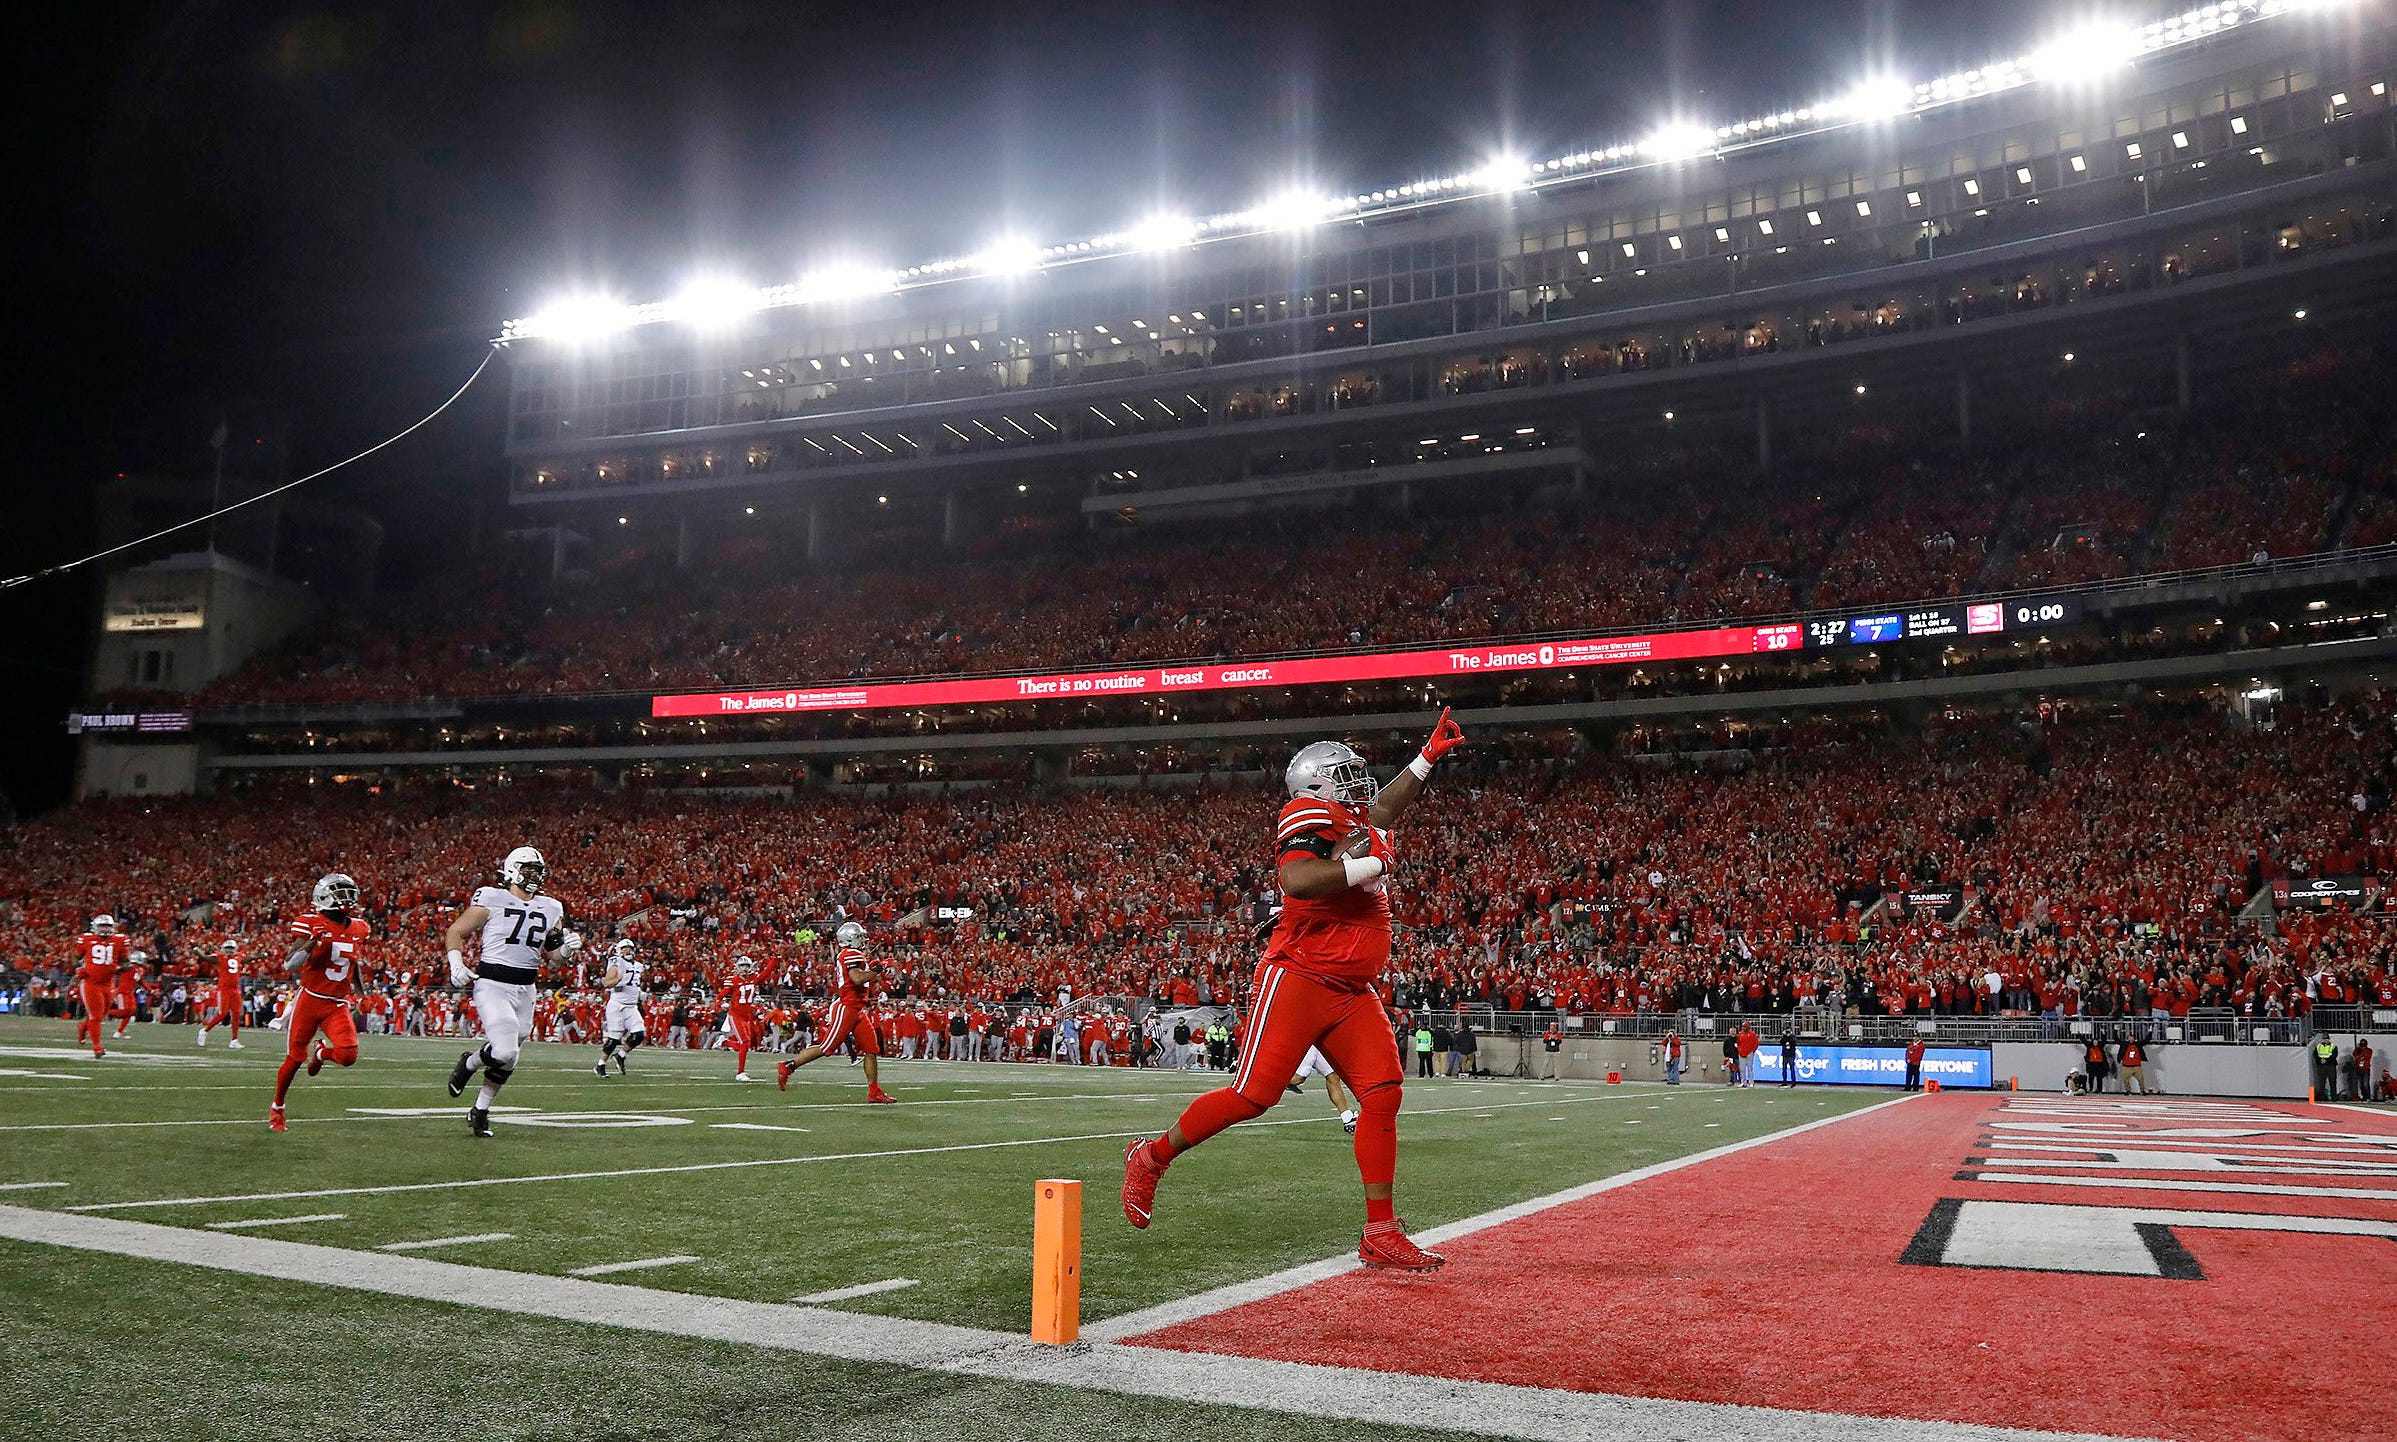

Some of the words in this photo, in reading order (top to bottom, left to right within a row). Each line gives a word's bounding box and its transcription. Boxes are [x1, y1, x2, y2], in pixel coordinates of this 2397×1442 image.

[1879, 615, 1898, 625] STATE
[2017, 604, 2064, 623] 0:00
[1775, 625, 1798, 635] STATE
[1810, 620, 1847, 636] 2:27
[1870, 625, 1883, 641] 7
[1923, 625, 1958, 637] QUARTER
[1767, 634, 1788, 650] 10
[1819, 634, 1835, 646] 25
[1448, 653, 1481, 669] The
[1483, 650, 1537, 668] James
[1017, 678, 1057, 695] There
[1059, 677, 1071, 692] is
[1073, 679, 1092, 691] no
[1094, 674, 1146, 690] routine
[1160, 669, 1204, 686] breast
[1220, 667, 1273, 683] cancer.
[719, 696, 743, 711] The
[744, 695, 785, 710] James
[104, 714, 136, 727] BROWN
[1908, 893, 1953, 901] TANSKY
[504, 907, 548, 949] 72
[91, 945, 114, 965] 91
[324, 941, 354, 982] 5
[228, 957, 239, 974] 9
[738, 983, 755, 1004] 17
[1841, 1059, 1877, 1072] FRESH
[1880, 1059, 1907, 1073] FOR
[1917, 1060, 1975, 1074] VERYONE
[1608, 1072, 1619, 1082] 10
